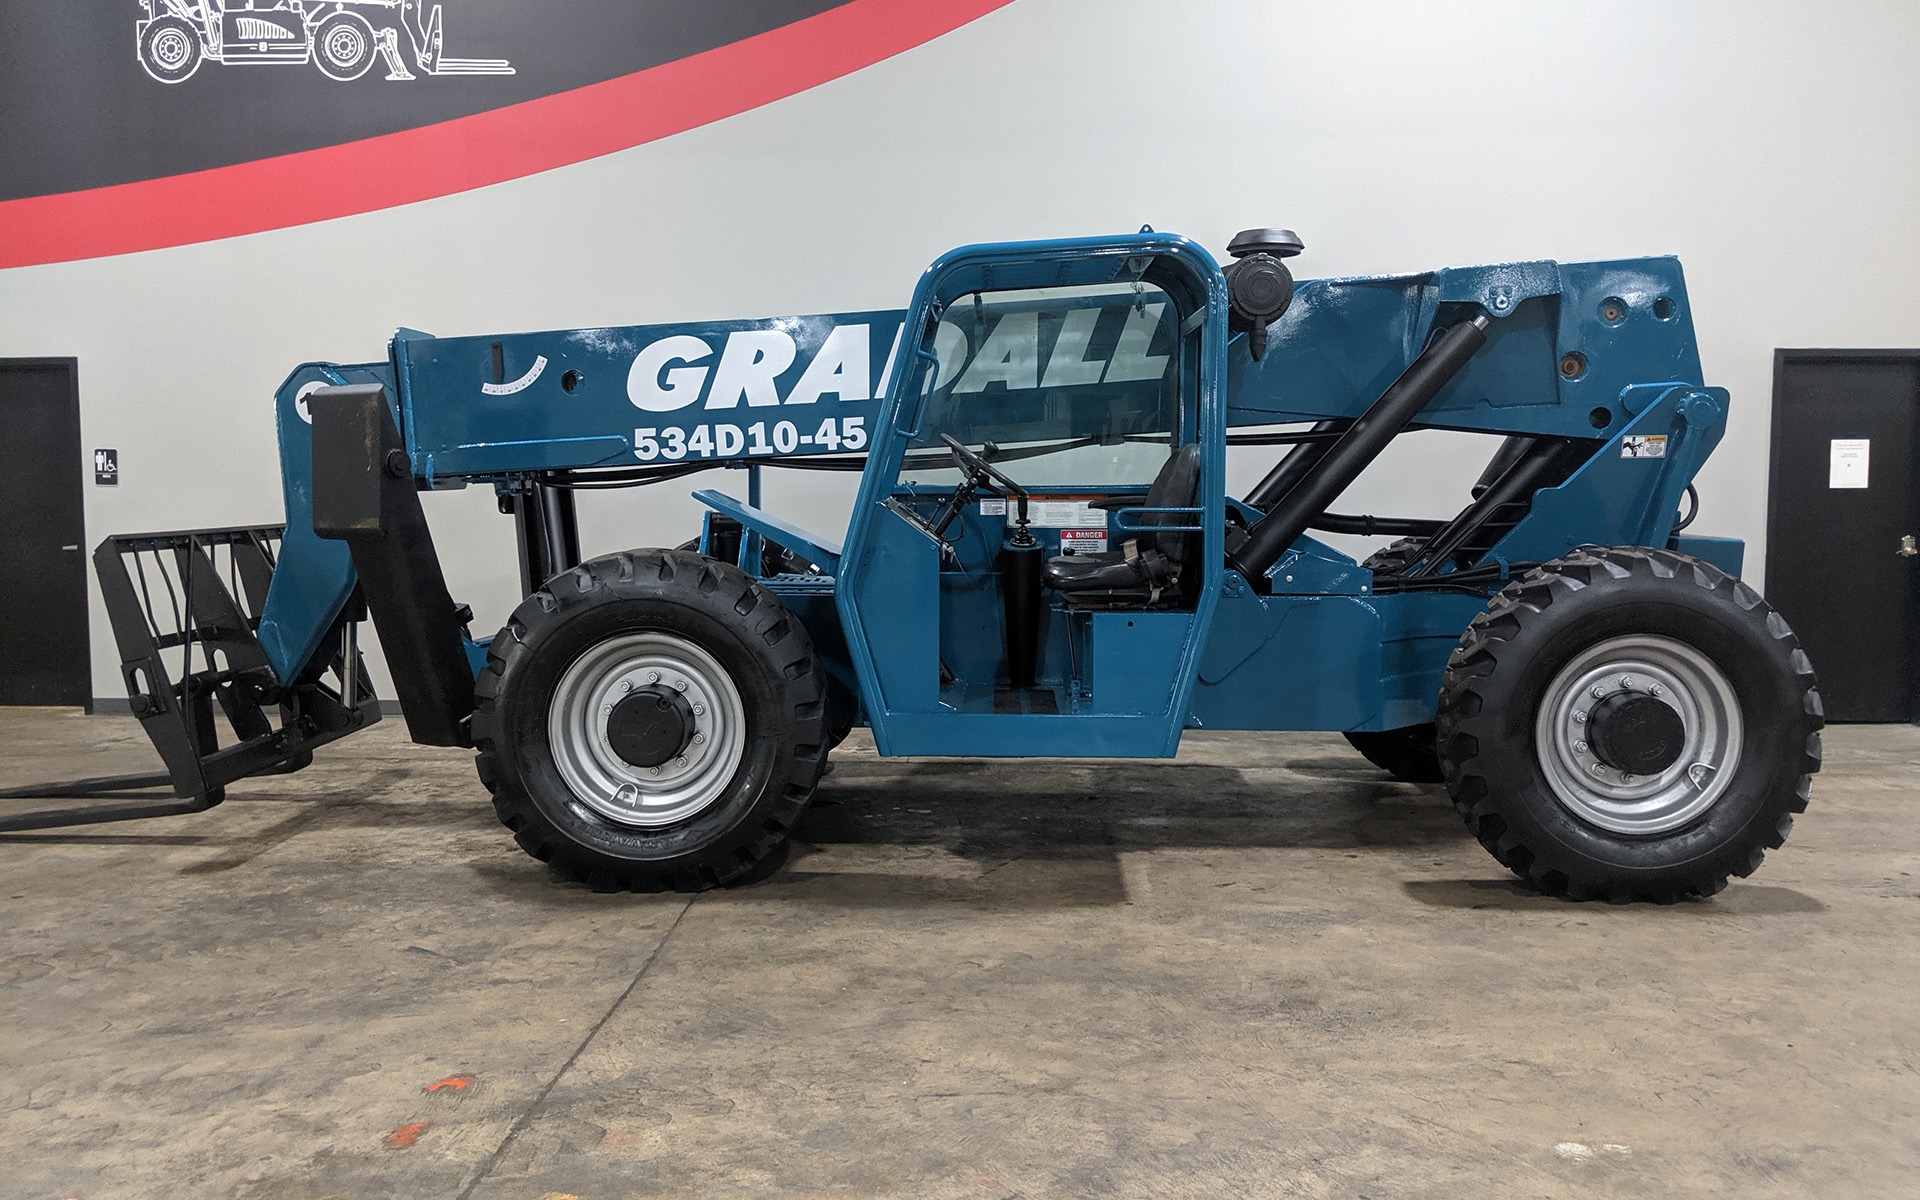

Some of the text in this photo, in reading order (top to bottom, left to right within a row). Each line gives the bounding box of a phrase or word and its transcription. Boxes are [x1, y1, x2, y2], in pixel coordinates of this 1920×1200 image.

[627, 303, 1170, 411] GRADALL
[634, 417, 867, 460] 534D10-45
[1075, 531, 1103, 539] DANGER
